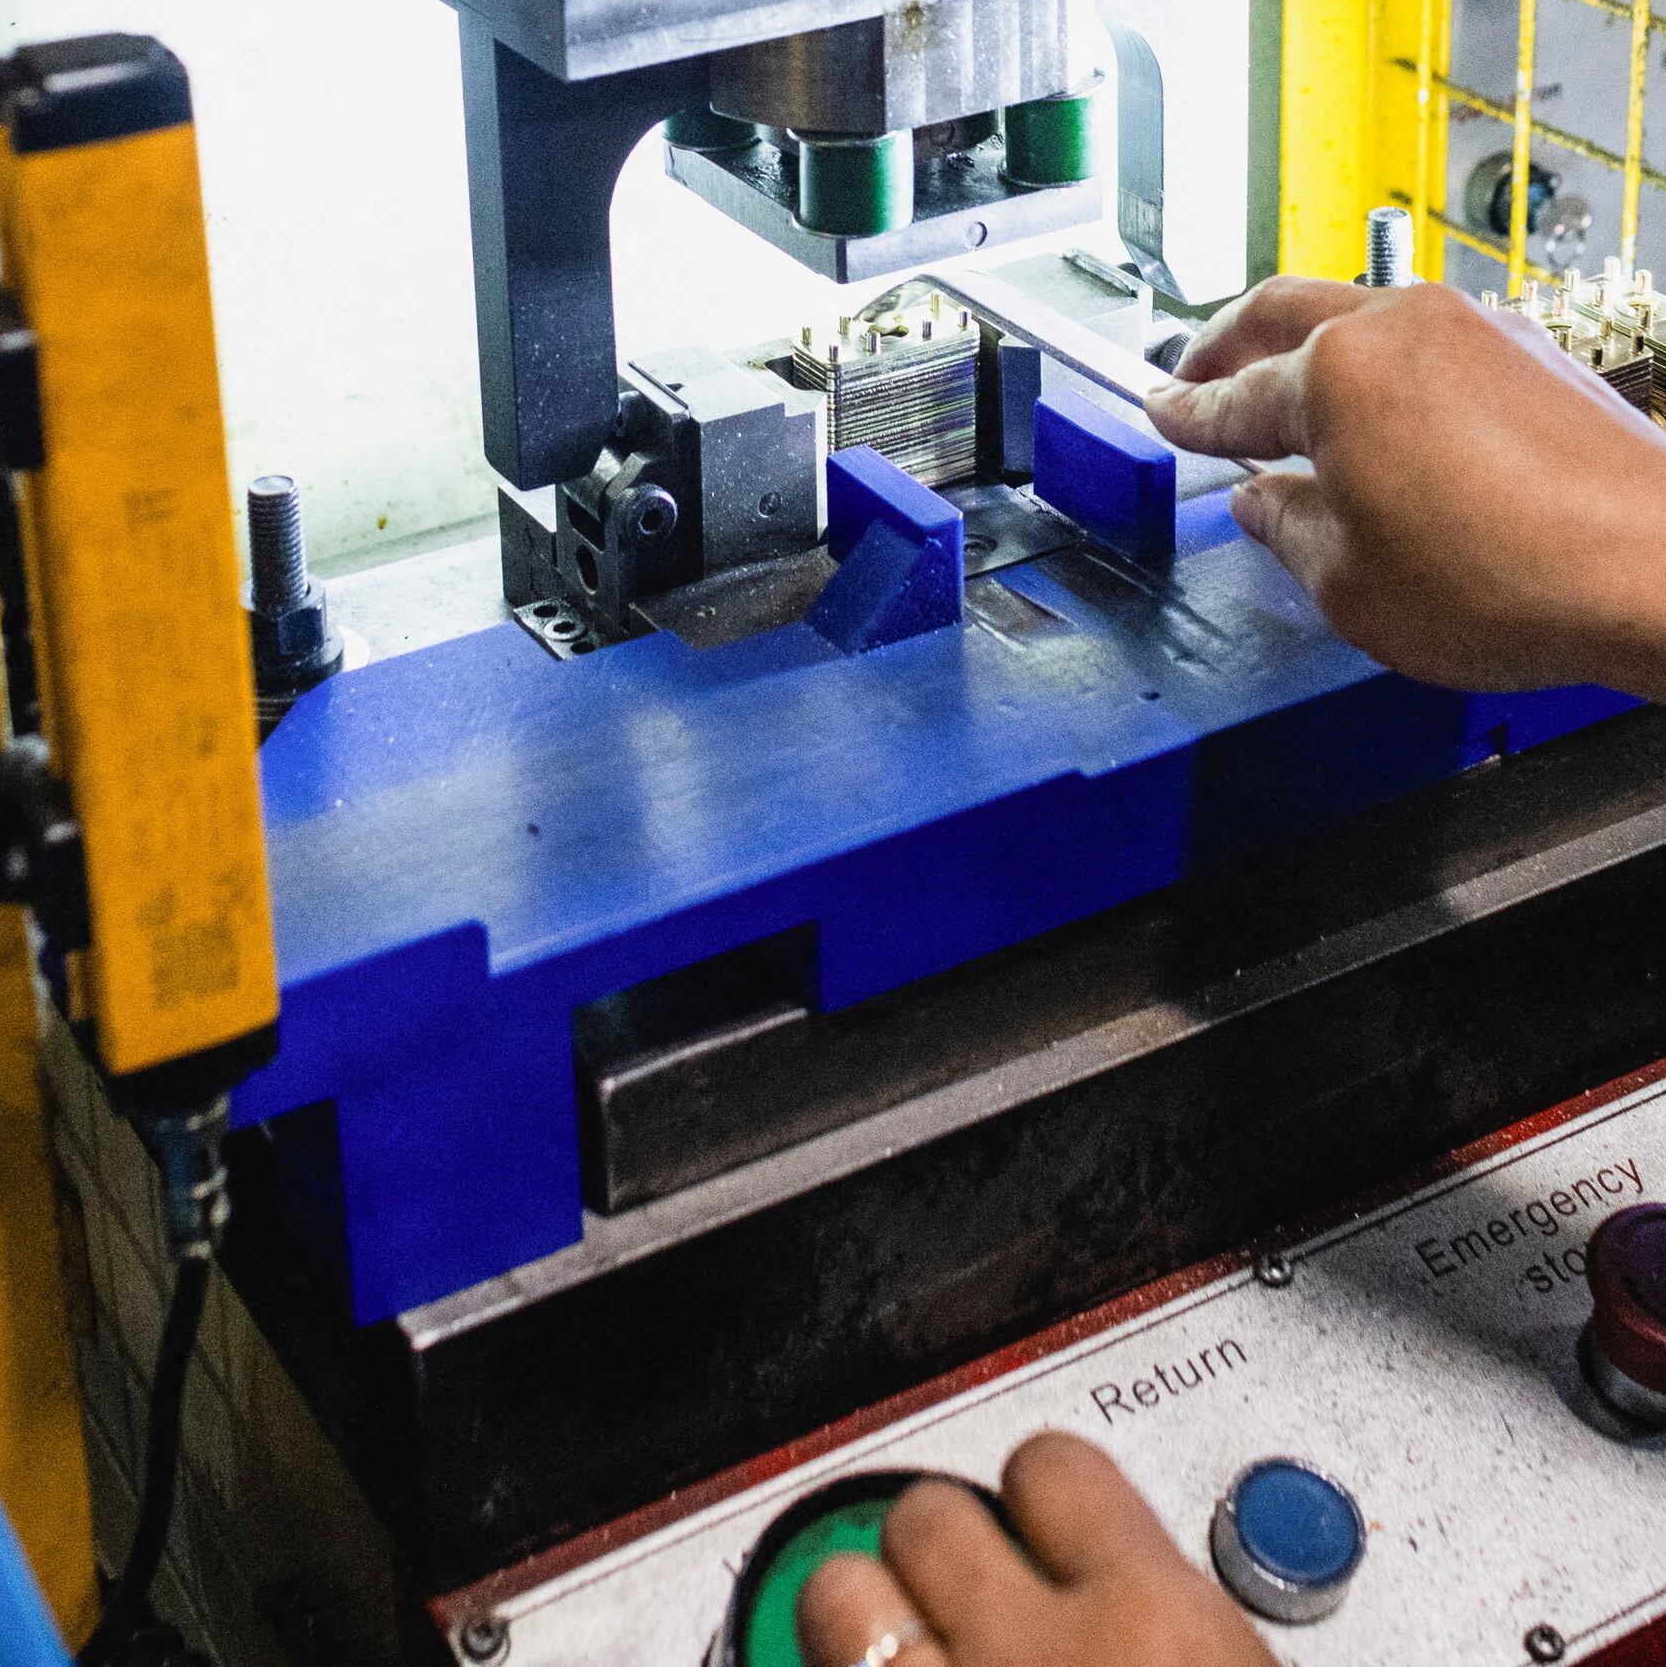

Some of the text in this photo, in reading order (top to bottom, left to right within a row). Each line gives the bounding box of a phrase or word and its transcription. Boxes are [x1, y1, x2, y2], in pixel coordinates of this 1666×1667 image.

[1415, 1157, 1644, 1278] Emergency
[1525, 1248, 1587, 1293] sto
[1090, 1339, 1248, 1425] Return
